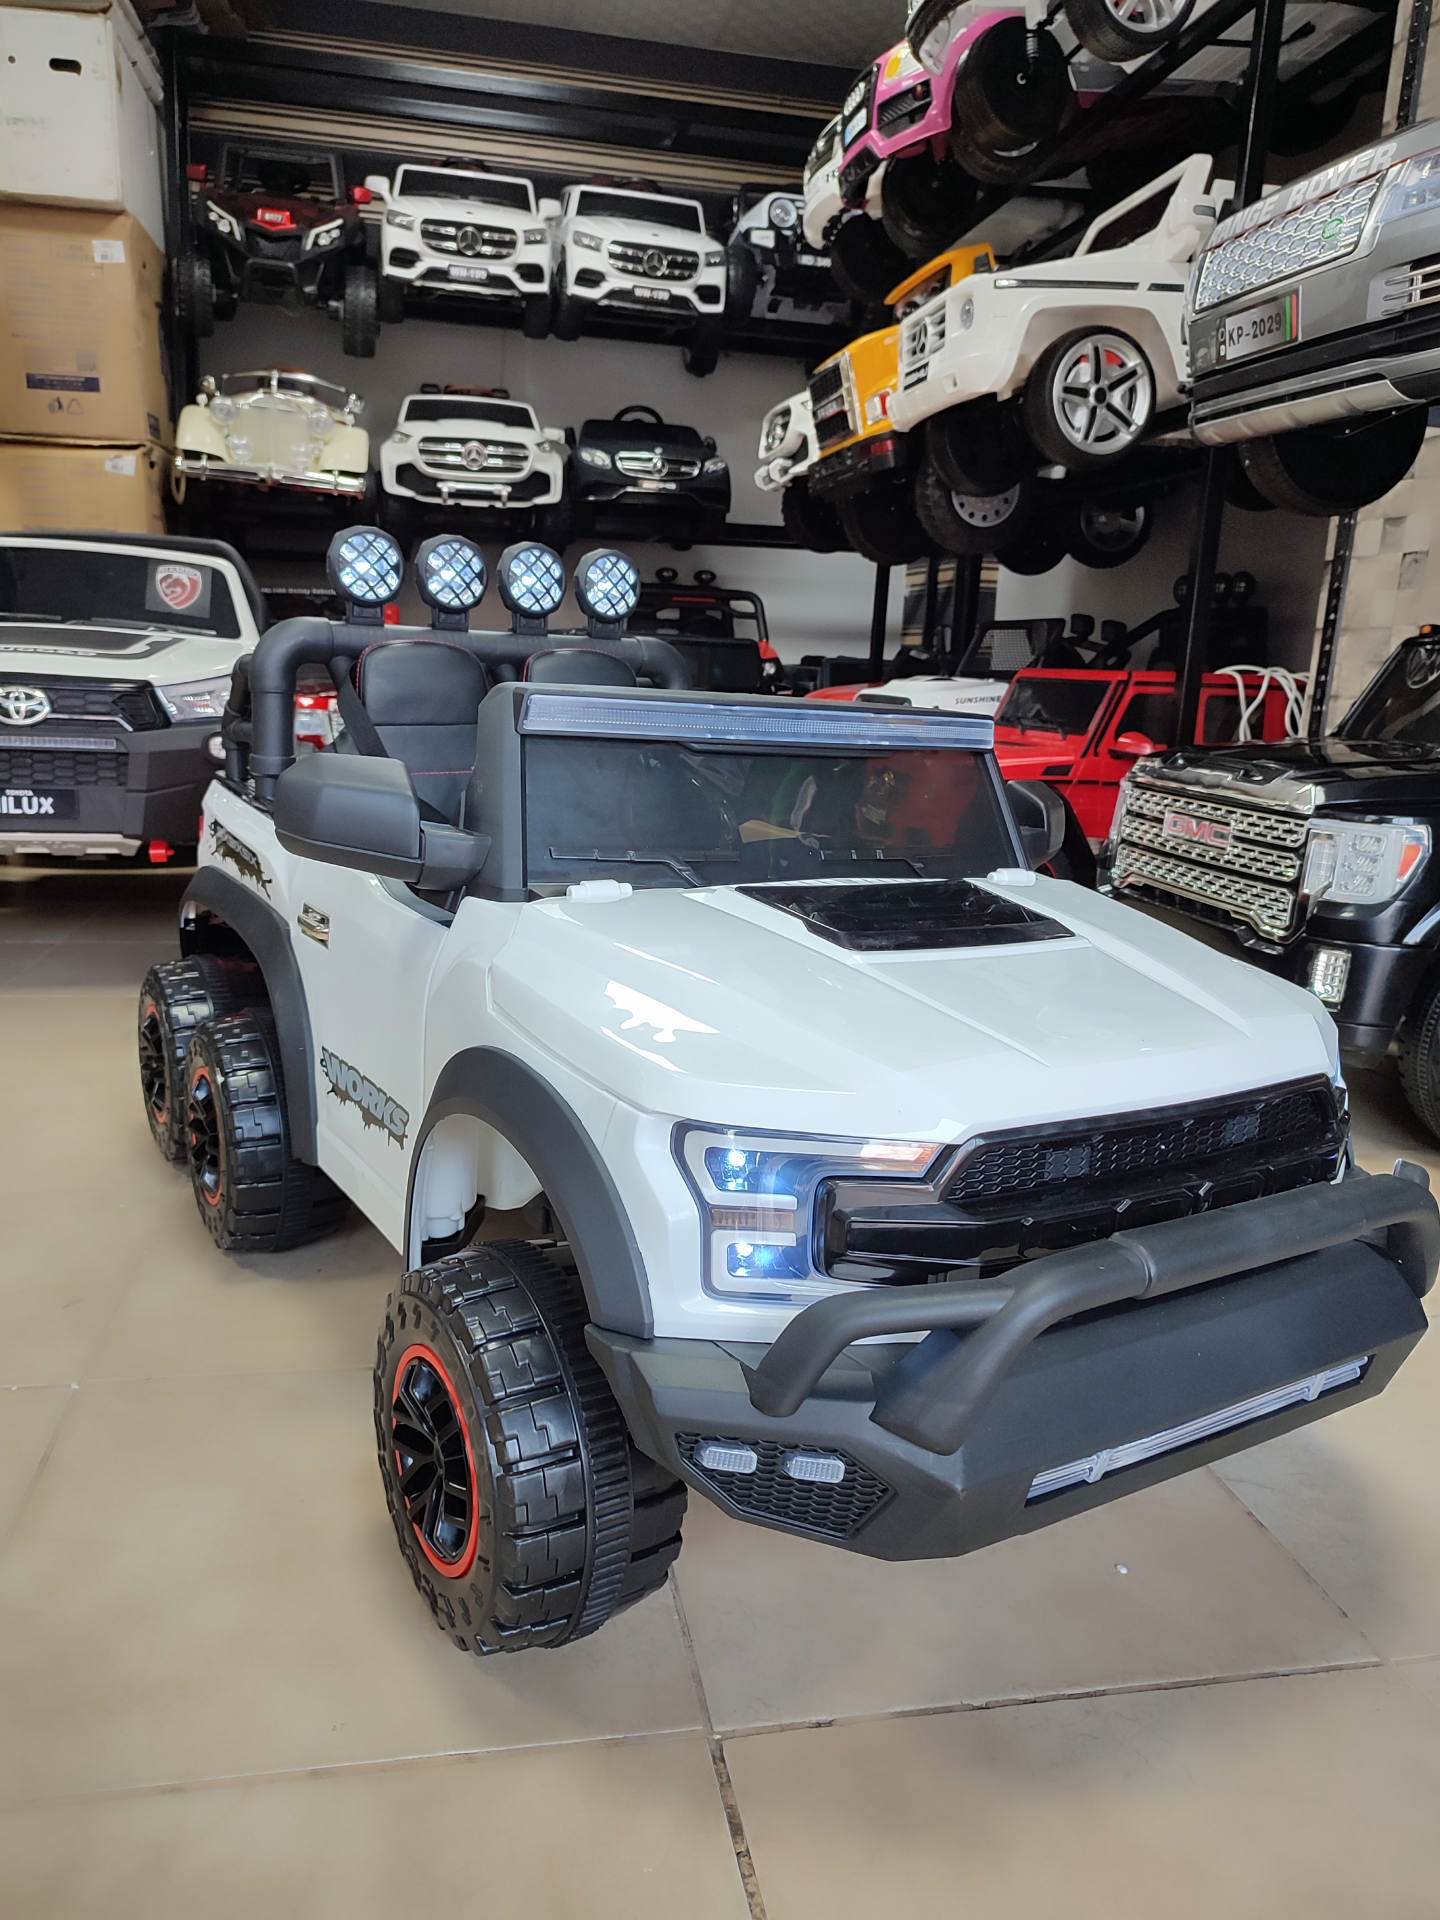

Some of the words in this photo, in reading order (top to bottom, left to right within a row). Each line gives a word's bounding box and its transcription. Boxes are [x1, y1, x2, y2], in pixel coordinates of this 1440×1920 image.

[1286, 142, 1398, 210] ROVER
[1228, 311, 1282, 347] KP-2029
[954, 695, 1001, 705] SUNSHINE
[0, 795, 55, 815] ILUX
[5, 789, 34, 797] TOYOTA
[1167, 814, 1232, 848] GMC
[321, 1045, 410, 1137] WORKS
